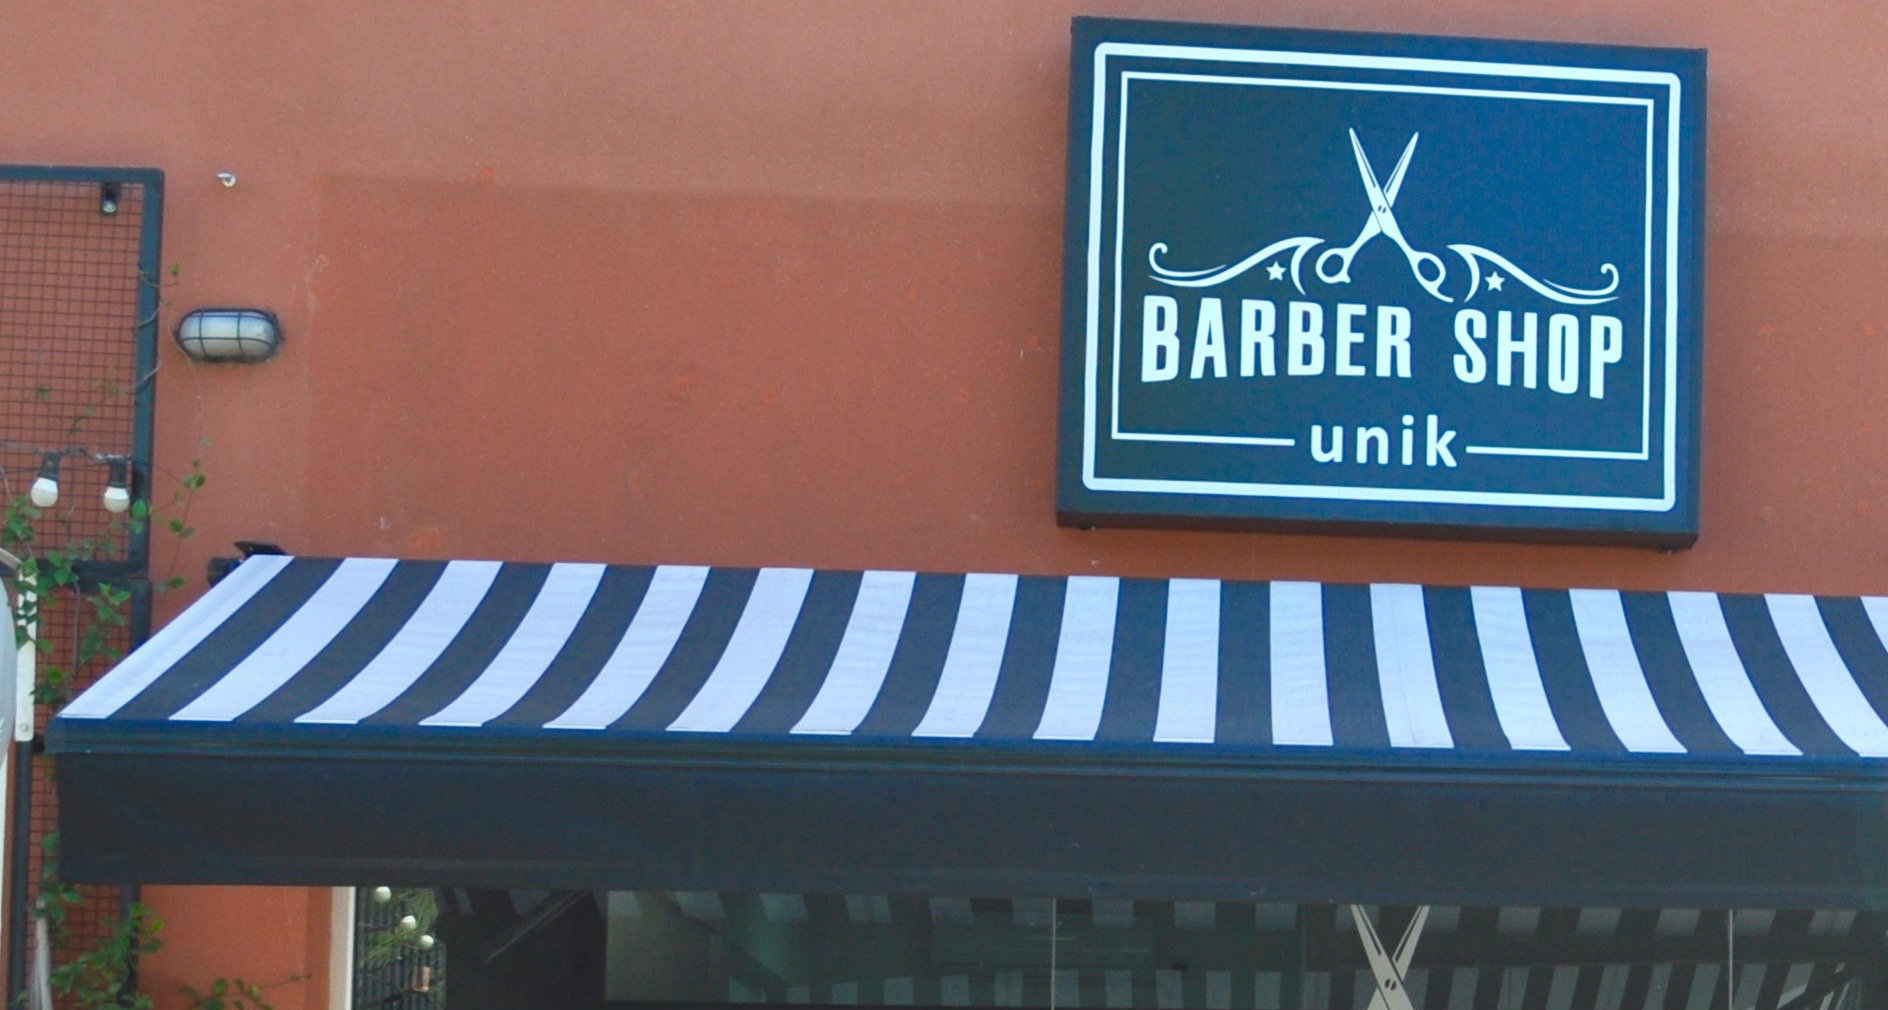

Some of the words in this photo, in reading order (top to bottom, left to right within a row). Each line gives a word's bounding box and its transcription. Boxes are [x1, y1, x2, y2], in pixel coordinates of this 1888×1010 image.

[1141, 294, 1413, 383] BARBER
[1452, 307, 1623, 400] SHOP
[1310, 413, 1459, 468] unik
